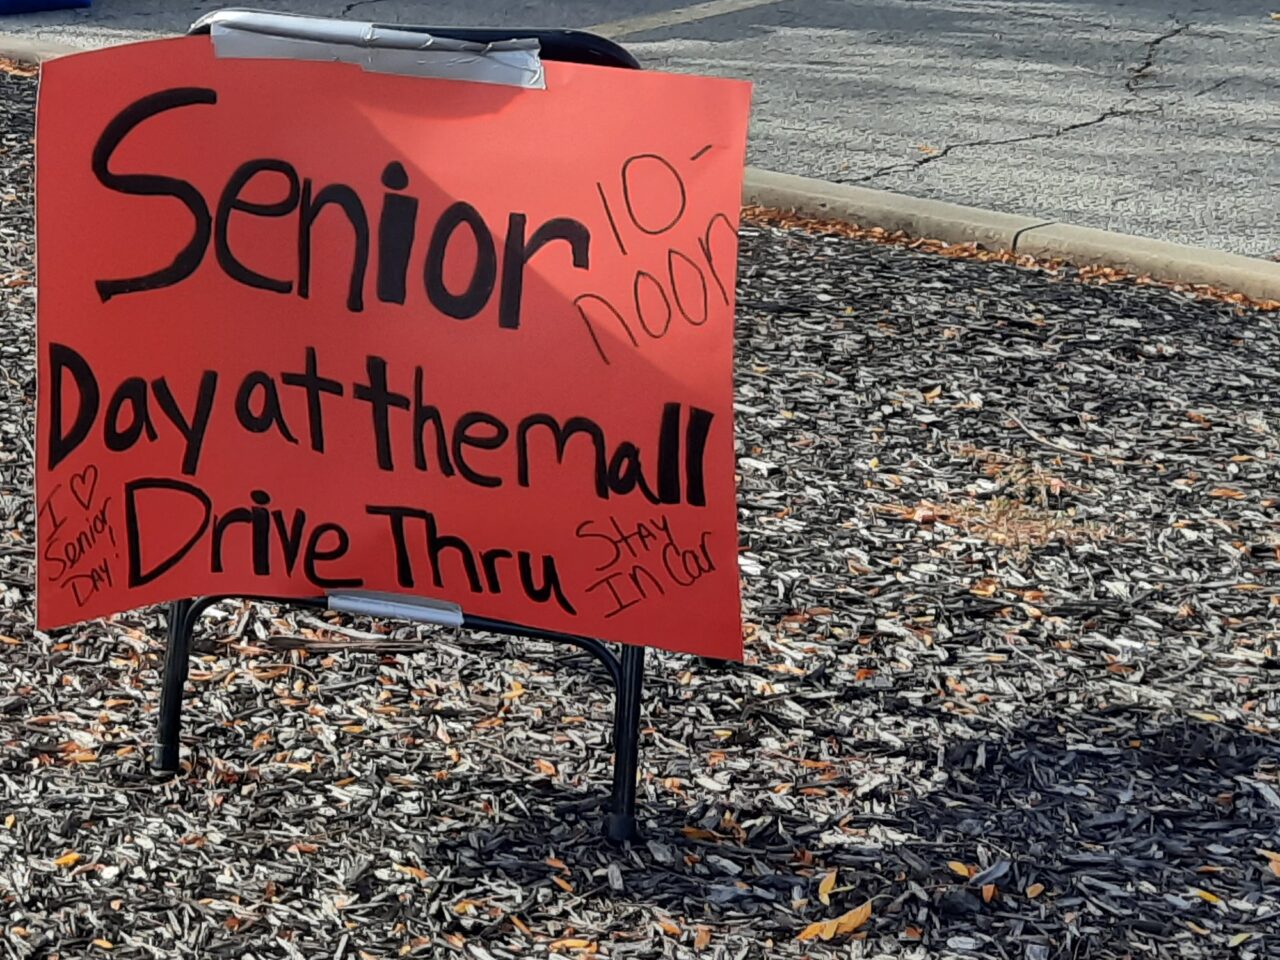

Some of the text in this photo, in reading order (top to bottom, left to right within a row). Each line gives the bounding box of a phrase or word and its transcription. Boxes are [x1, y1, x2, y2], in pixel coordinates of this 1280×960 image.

[91, 87, 591, 329] Senior
[573, 212, 739, 365] noon
[48, 342, 219, 476] Day
[234, 346, 344, 454] at
[44, 496, 113, 582] Senior
[125, 478, 577, 616] Drive Thru
[584, 565, 666, 619] In
